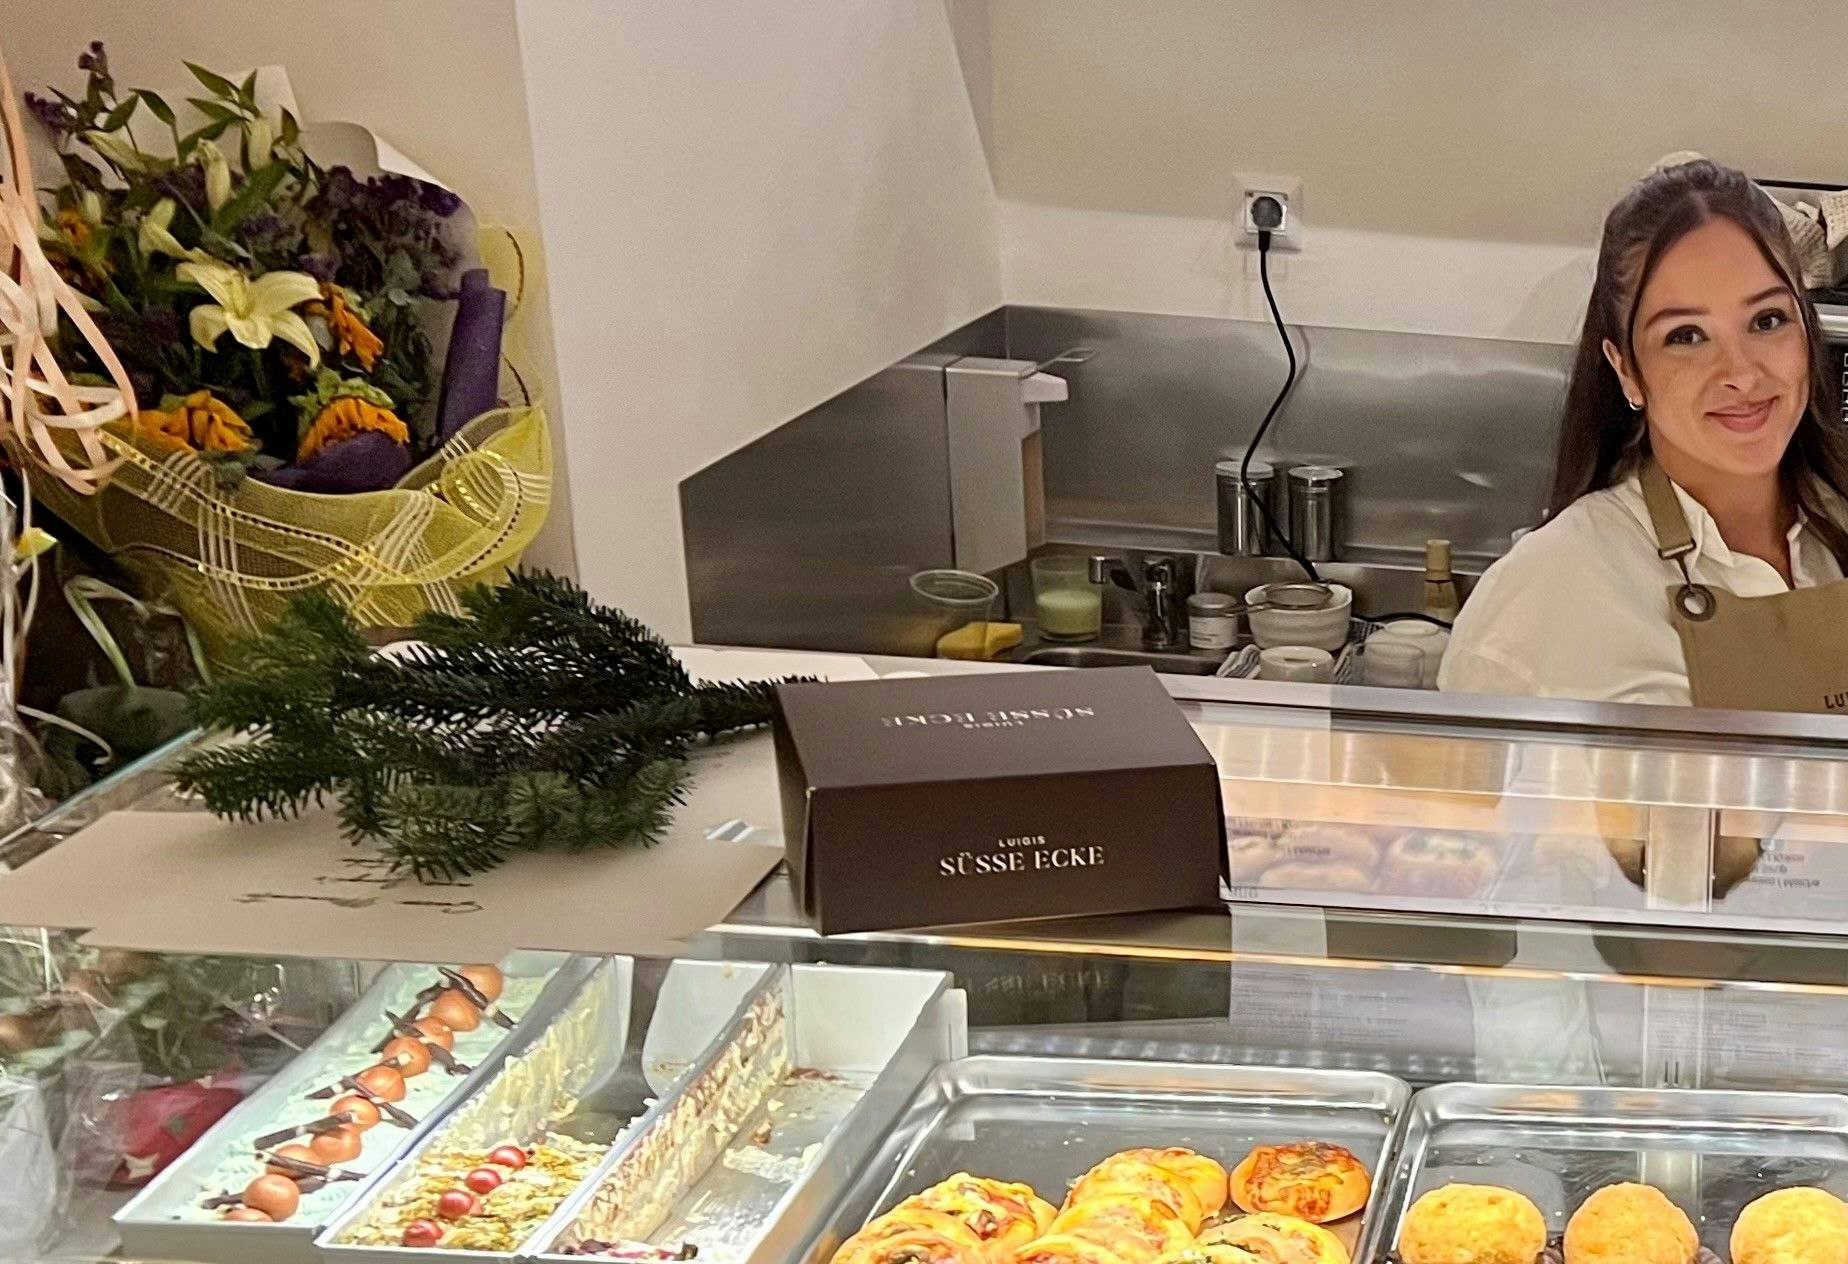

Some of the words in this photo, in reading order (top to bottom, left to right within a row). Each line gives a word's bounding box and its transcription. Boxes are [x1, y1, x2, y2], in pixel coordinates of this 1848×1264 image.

[998, 835, 1046, 848] LUIGIS
[940, 851, 1025, 876] SÜSSE
[1034, 845, 1104, 870] ECKE
